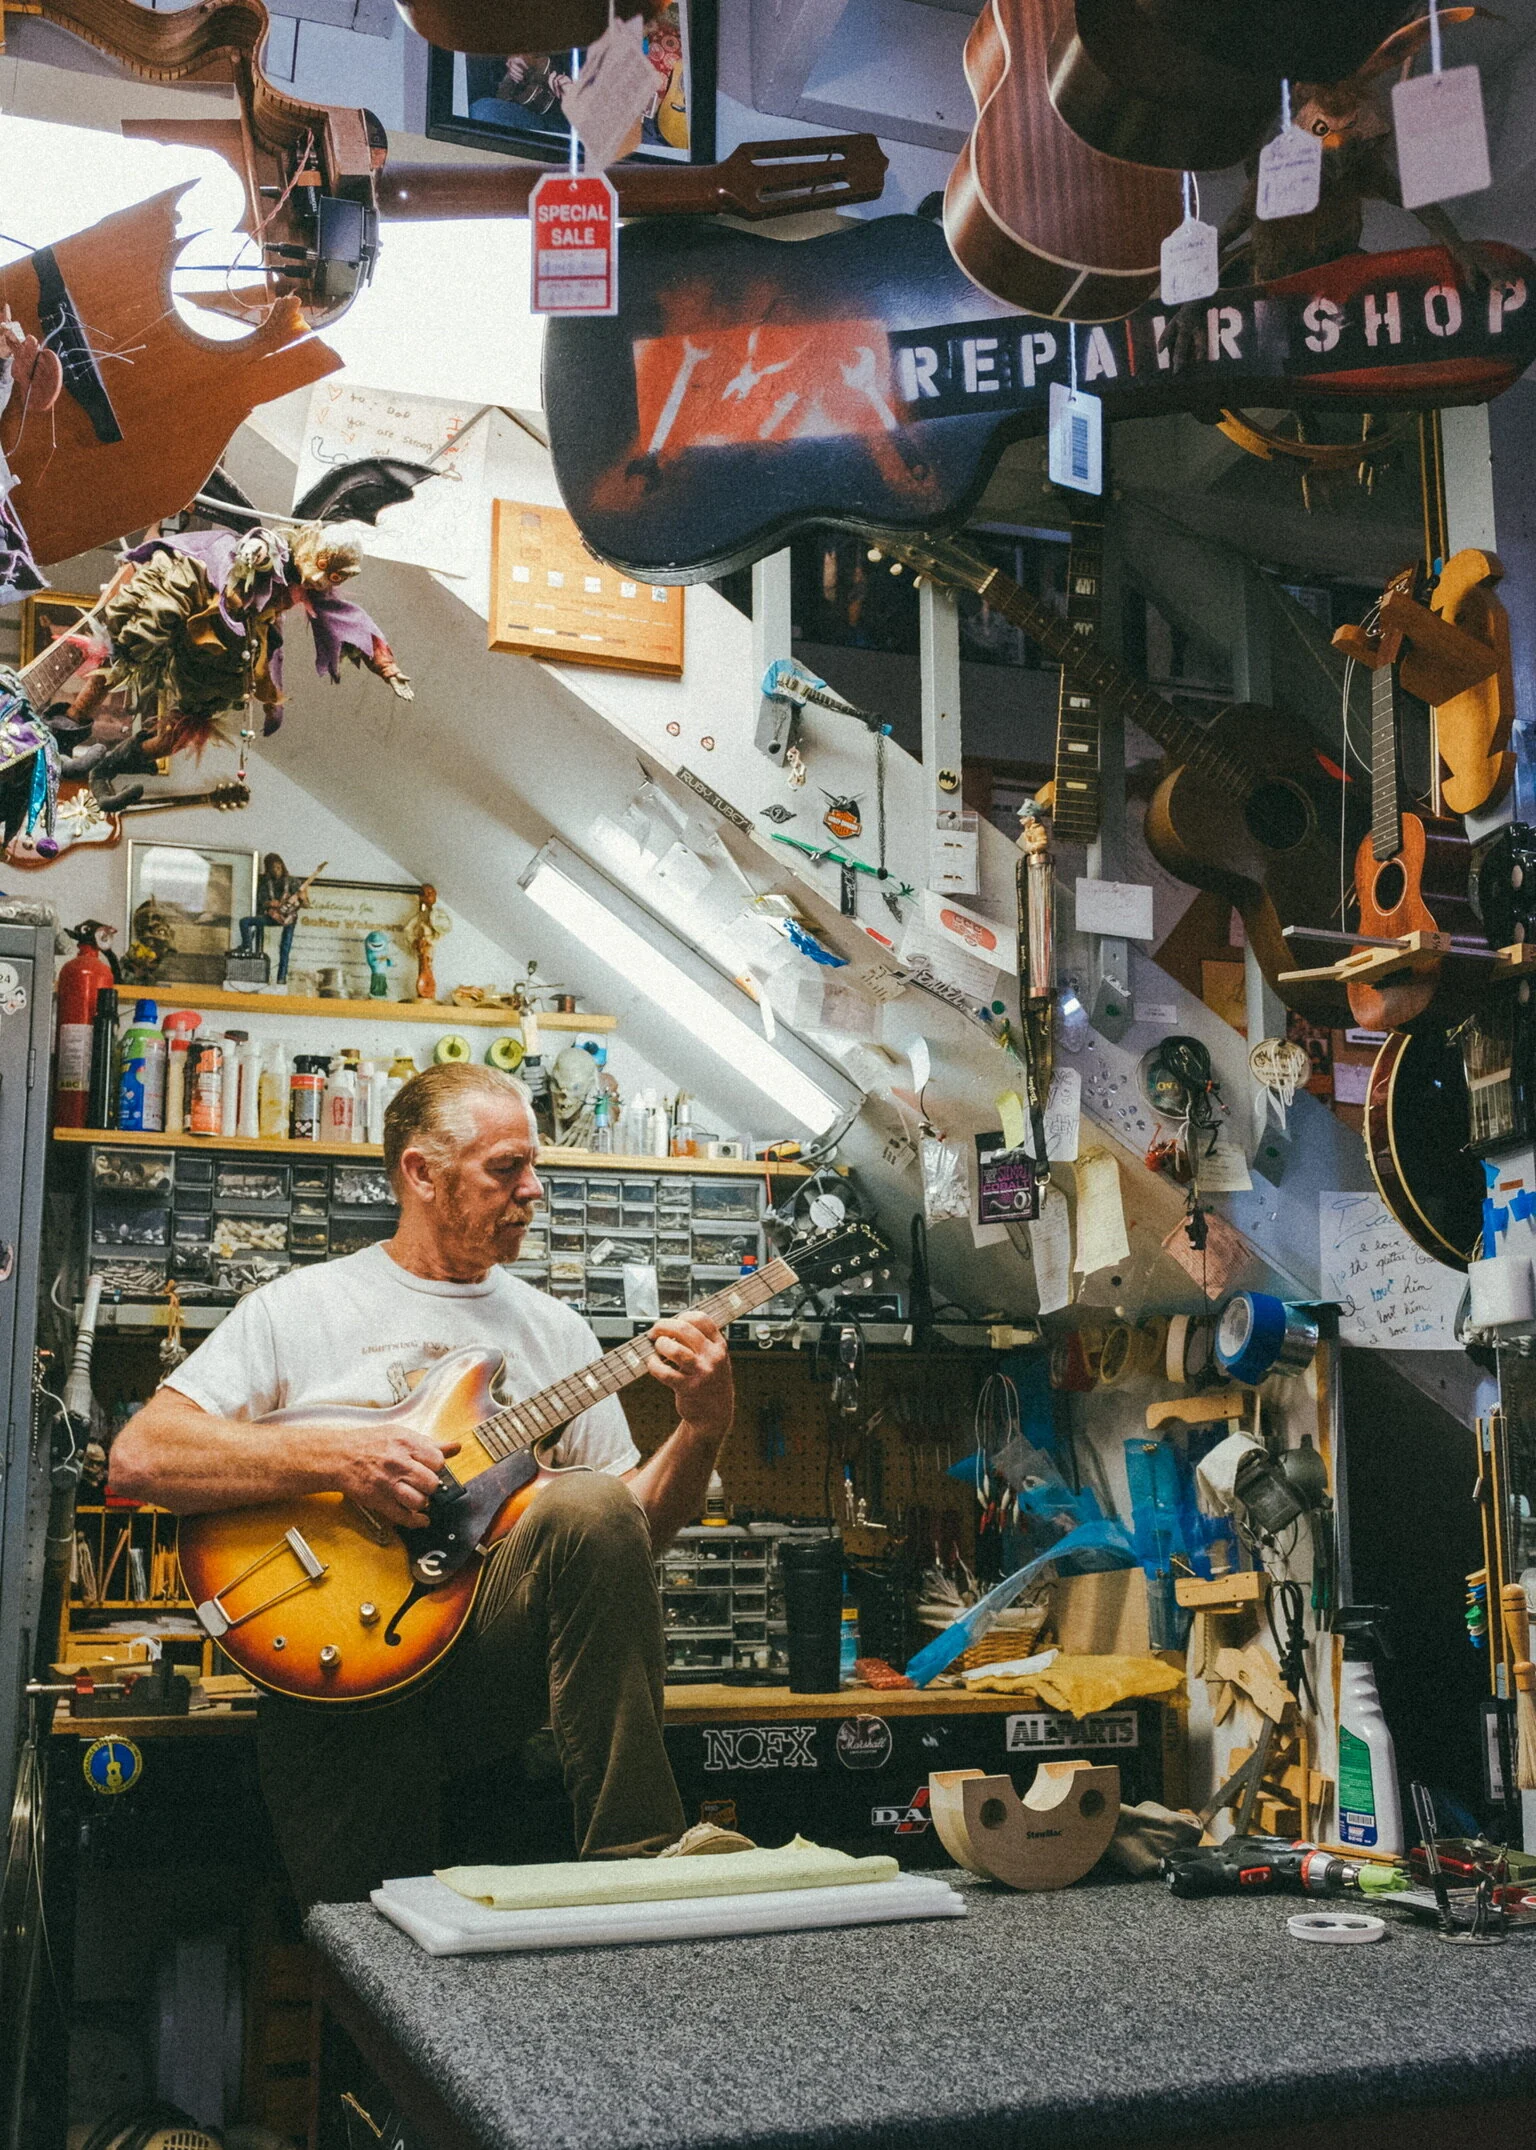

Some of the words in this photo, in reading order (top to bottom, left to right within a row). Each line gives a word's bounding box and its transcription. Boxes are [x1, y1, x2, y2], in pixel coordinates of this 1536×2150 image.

[537, 204, 608, 223] SPECIAL
[551, 227, 595, 245] SALE
[898, 304, 1243, 400] REPAIR
[1302, 283, 1528, 353] SHOP
[679, 770, 713, 803] RUBY
[711, 796, 750, 832] TUBES
[983, 1179, 1029, 1191] COBALT
[1375, 1238, 1401, 1251] love
[1402, 1274, 1433, 1295] him
[1388, 1325, 1410, 1338] love
[703, 1726, 818, 1771] NOFX
[840, 1735, 887, 1750] Marshall
[1026, 1829, 1062, 1840] StewMac
